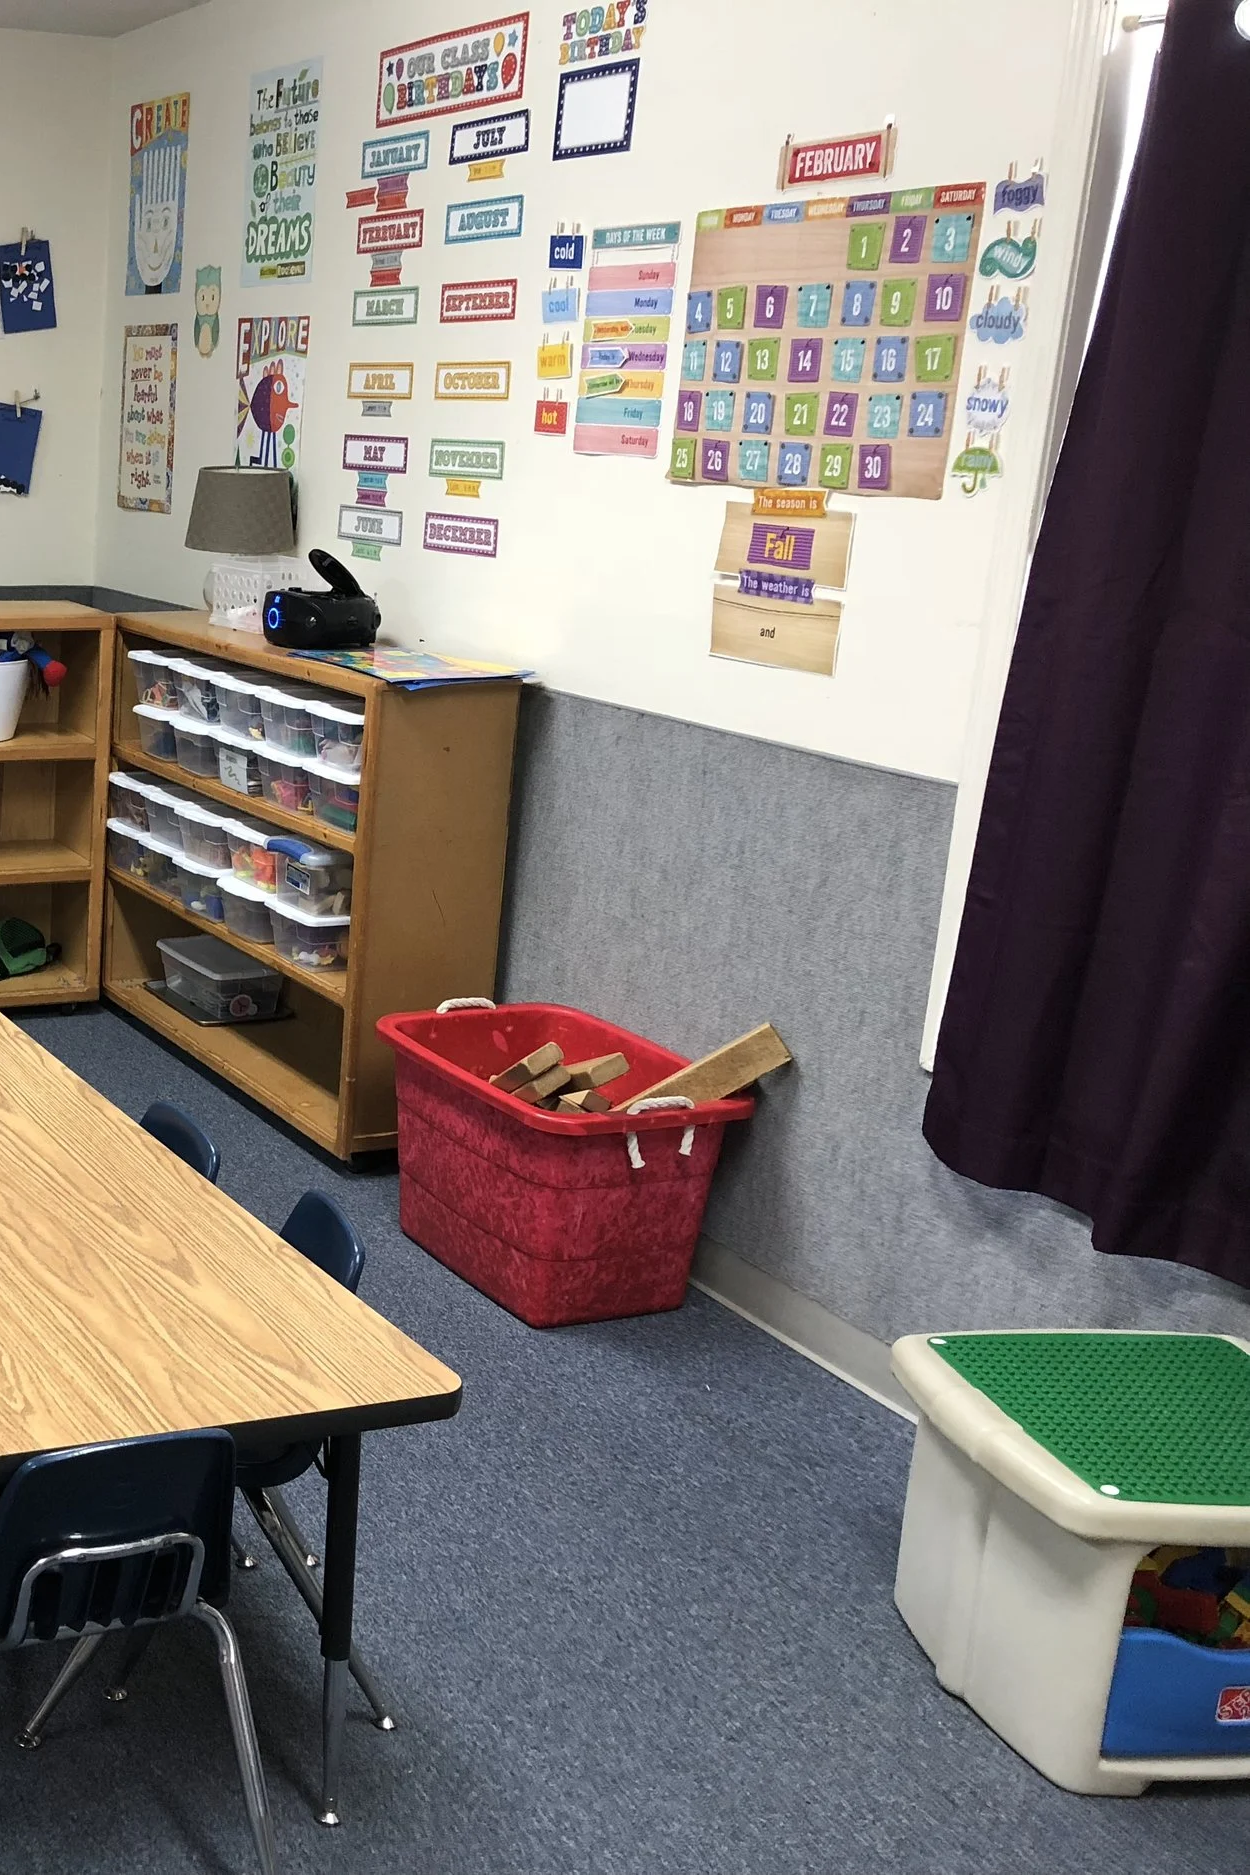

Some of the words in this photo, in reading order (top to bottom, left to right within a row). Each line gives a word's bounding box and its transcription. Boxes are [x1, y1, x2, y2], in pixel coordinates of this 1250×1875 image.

[563, 0, 647, 40] TODAY'S
[558, 26, 645, 65] BIRTHDAY
[407, 52, 435, 78] OUR
[441, 38, 490, 69] CLASS
[257, 88, 274, 111] The
[276, 78, 319, 108] Future
[397, 61, 499, 110] BIRTHDAYS
[132, 98, 187, 149] CREATE
[294, 109, 319, 126] those
[473, 127, 506, 149] JULY
[253, 139, 273, 160] who
[369, 143, 421, 168] JANUARY
[795, 140, 877, 179] FEBRUARY
[273, 189, 301, 213] their
[940, 189, 977, 203] SATURDAY
[1002, 182, 1039, 206] foggy
[771, 208, 797, 220] TUESDAY
[853, 199, 886, 212] THURSDAY
[458, 208, 509, 231] AUGUST
[247, 218, 310, 257] DREAMS
[361, 222, 418, 244] FEBRUARY
[605, 231, 622, 245] DAYS
[623, 230, 631, 243] OF
[632, 229, 644, 242] THE
[645, 227, 666, 242] WEEK
[861, 236, 868, 258] 1
[902, 229, 911, 252] 2
[945, 228, 954, 251] 3
[554, 243, 574, 260] cold
[993, 244, 1028, 273] windy
[638, 268, 660, 282] Sunday
[365, 298, 404, 317] MARCH
[445, 291, 510, 312] SEPTEMBER
[549, 297, 569, 314] cool
[634, 297, 659, 310] Monday
[694, 301, 702, 322] 4
[726, 298, 734, 319] 5
[765, 297, 774, 318] 6
[809, 296, 817, 317] 7
[852, 294, 861, 315] 8
[890, 292, 900, 314] 9
[936, 287, 952, 311] 10
[975, 311, 1021, 334] cloudy
[238, 318, 308, 373] EXPLORE
[540, 354, 566, 368] warm
[629, 350, 665, 363] Wednesday
[690, 351, 698, 371] 11
[720, 351, 731, 372] 12
[756, 349, 768, 370] 13
[798, 350, 812, 371] 14
[841, 349, 854, 371] 15
[881, 348, 896, 371] 16
[925, 347, 941, 371] 17
[131, 367, 152, 380] never
[154, 364, 163, 382] be
[363, 373, 396, 390] APRIL
[443, 372, 500, 390] OCTOBER
[147, 408, 163, 424] what
[541, 408, 558, 425] hot
[623, 407, 643, 420] Friday
[684, 401, 693, 421] 18
[713, 401, 725, 421] 19
[750, 402, 765, 424] 20
[793, 404, 808, 424] 21
[832, 404, 849, 426] 22
[874, 405, 891, 428] 23
[917, 403, 933, 426] 24
[966, 396, 1009, 418] snowy
[621, 434, 649, 448] Saturday
[363, 446, 386, 462] MAY
[434, 450, 498, 470] NOVEMBER
[676, 448, 688, 469] 25
[708, 450, 722, 470] 26
[746, 449, 761, 470] 27
[785, 452, 800, 474] 28
[825, 454, 841, 477] 29
[865, 455, 881, 478] 30
[758, 496, 772, 508] The
[776, 497, 805, 509] season
[809, 497, 817, 509] is
[354, 516, 383, 534] JUNE
[429, 522, 492, 547] DECEMBER
[764, 532, 795, 561] Fall
[742, 575, 758, 589] The
[762, 580, 798, 596] weather
[801, 584, 810, 597] is
[760, 627, 776, 639] and
